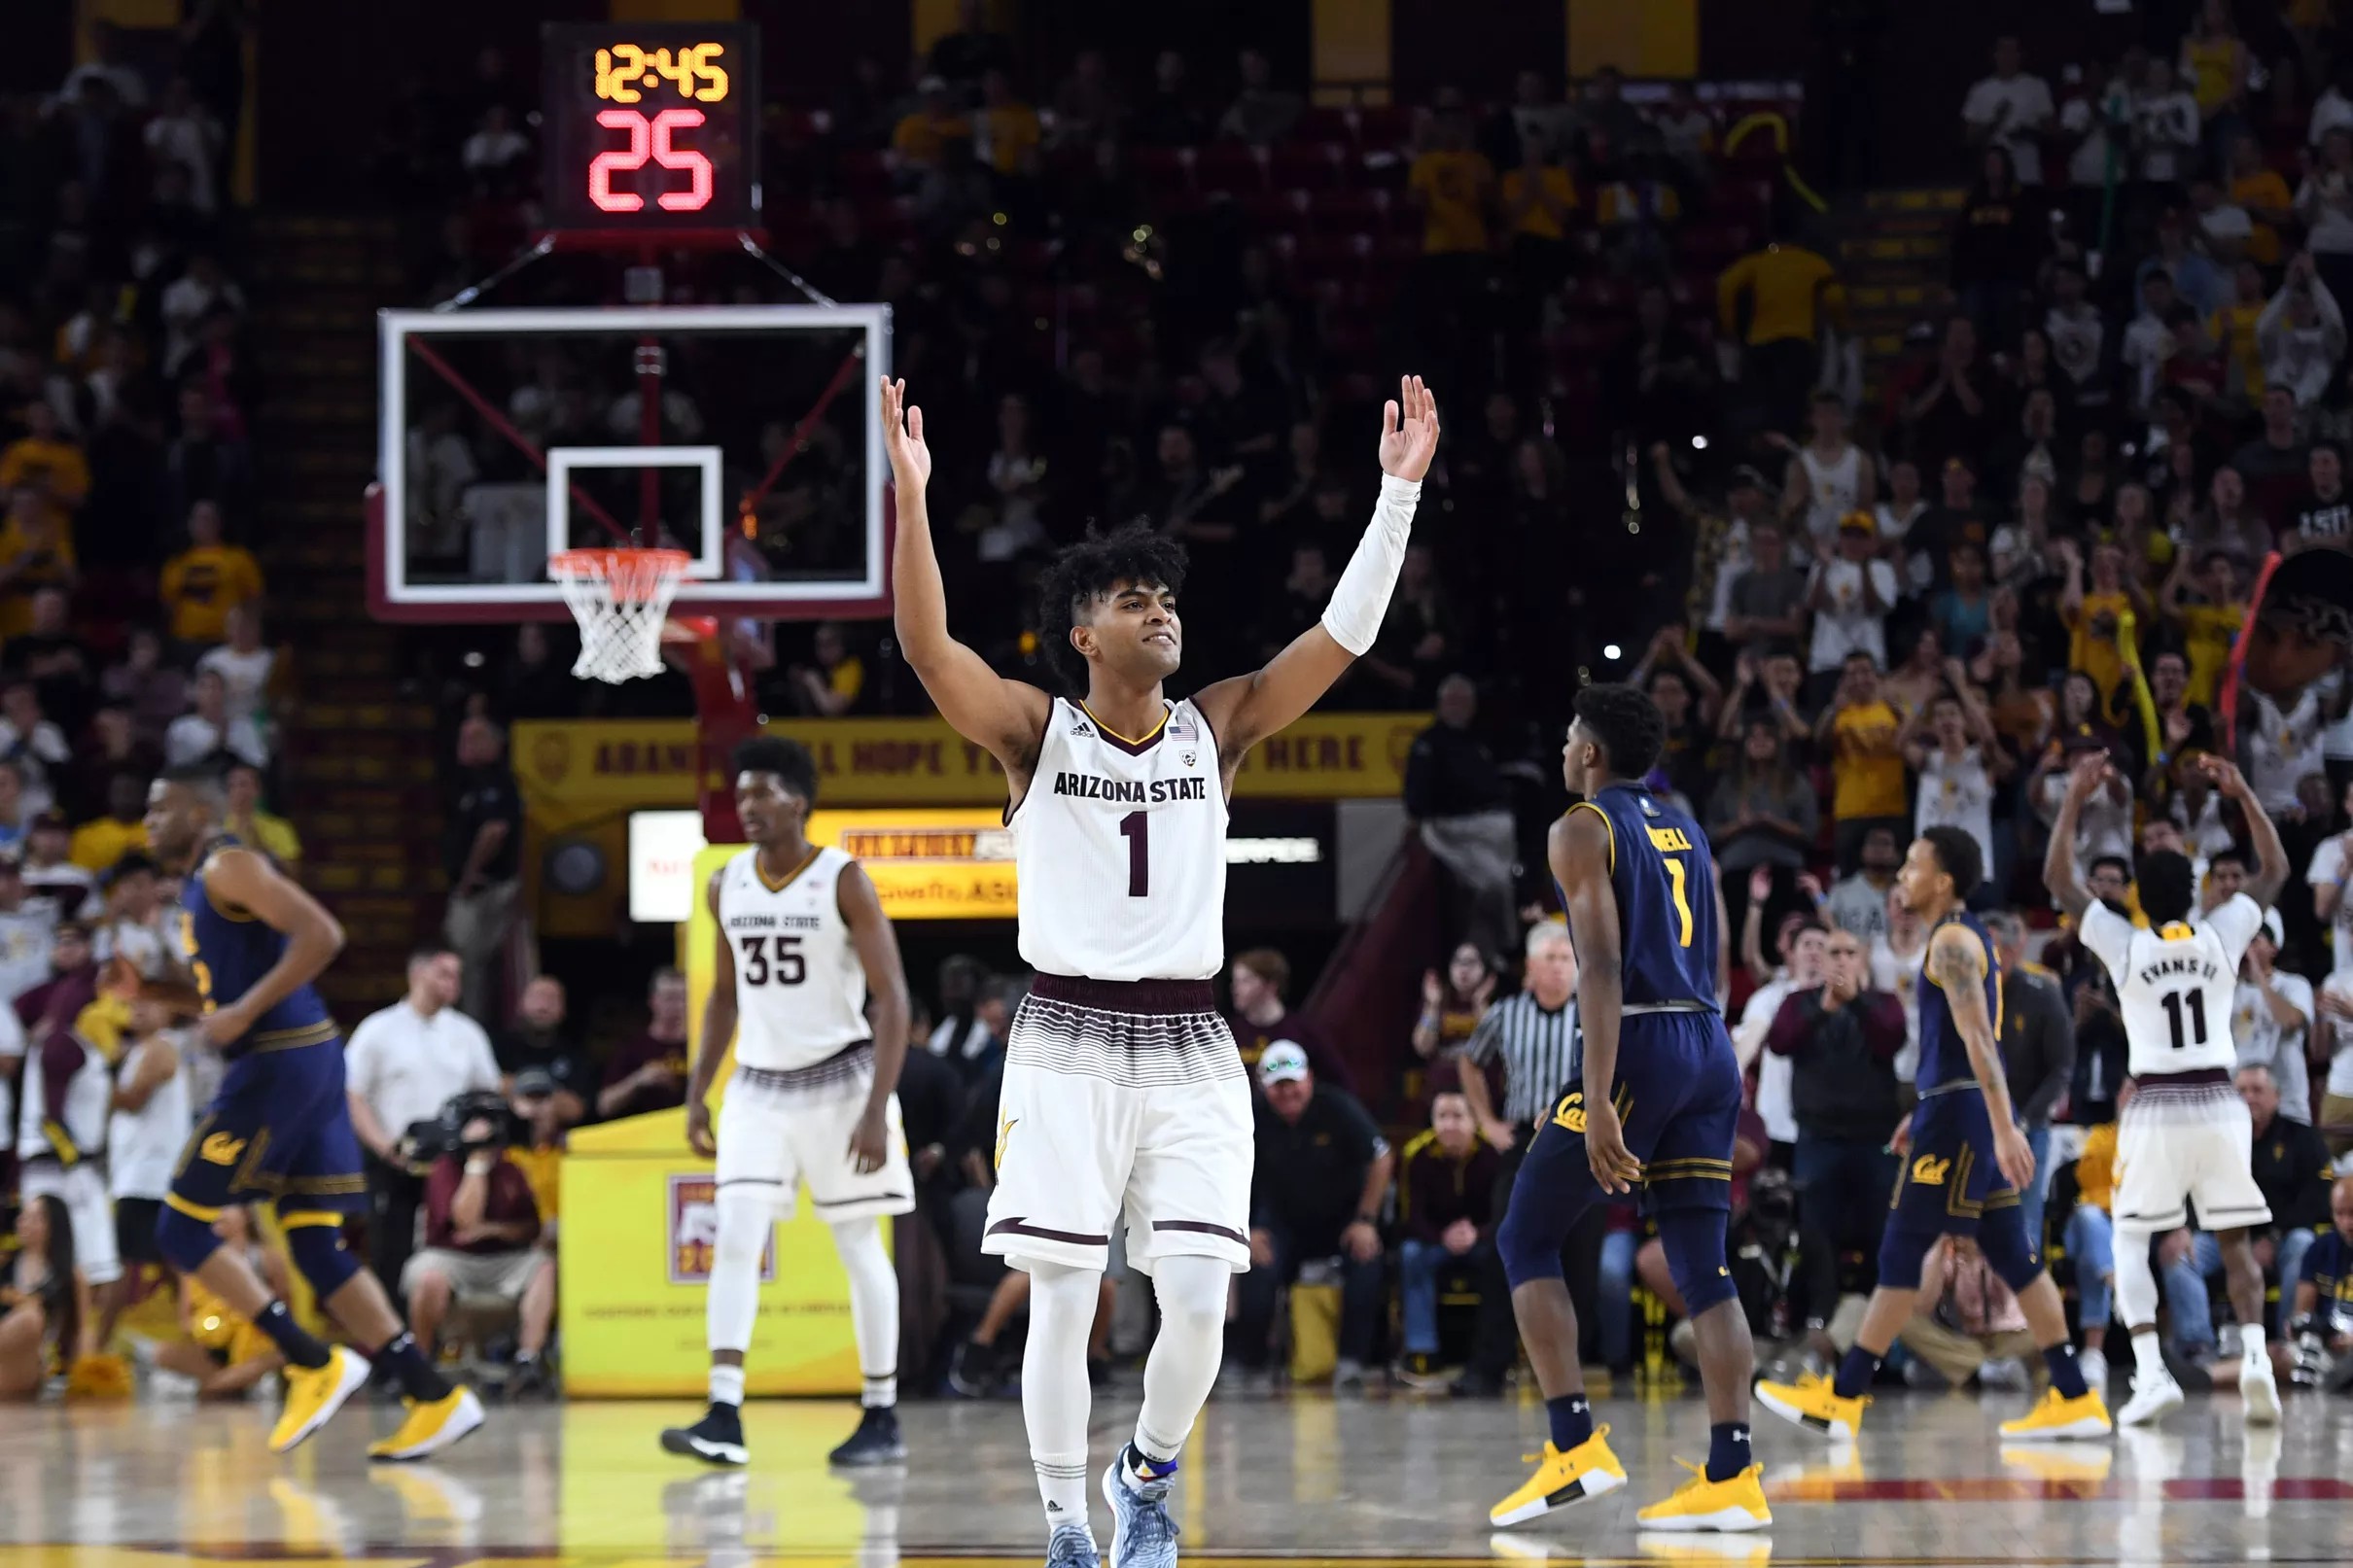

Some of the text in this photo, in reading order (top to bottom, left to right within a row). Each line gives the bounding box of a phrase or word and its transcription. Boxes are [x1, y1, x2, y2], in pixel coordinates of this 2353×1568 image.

[594, 43, 728, 104] 12:45
[589, 109, 713, 212] 25
[1071, 730, 1095, 739] adidas
[1053, 772, 1206, 803] ARIZONA STATE
[1119, 811, 1148, 897] 1
[1664, 858, 1694, 949] 1
[741, 936, 806, 986] 35
[2140, 957, 2199, 986] EVANS
[2160, 988, 2207, 1049] 11
